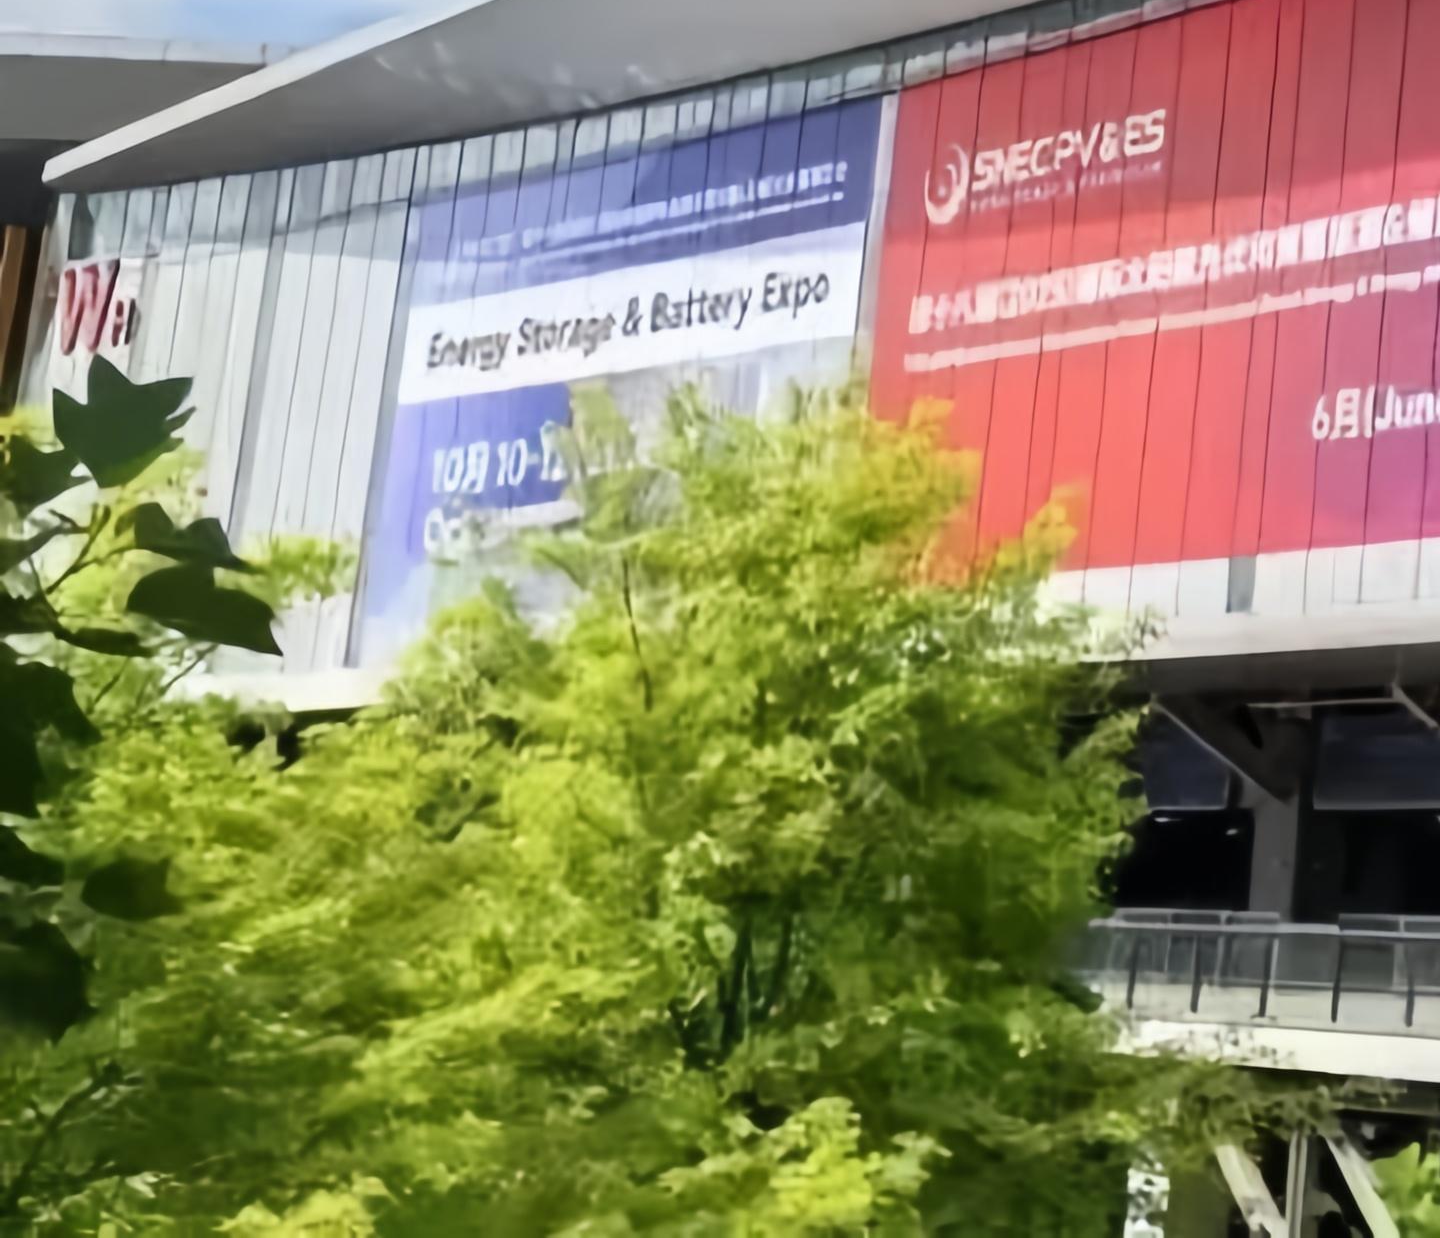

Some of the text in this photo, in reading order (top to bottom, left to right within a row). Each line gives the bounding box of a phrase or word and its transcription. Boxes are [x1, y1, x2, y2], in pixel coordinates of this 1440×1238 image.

[426, 270, 830, 371] Energy Storage & Battery Expo
